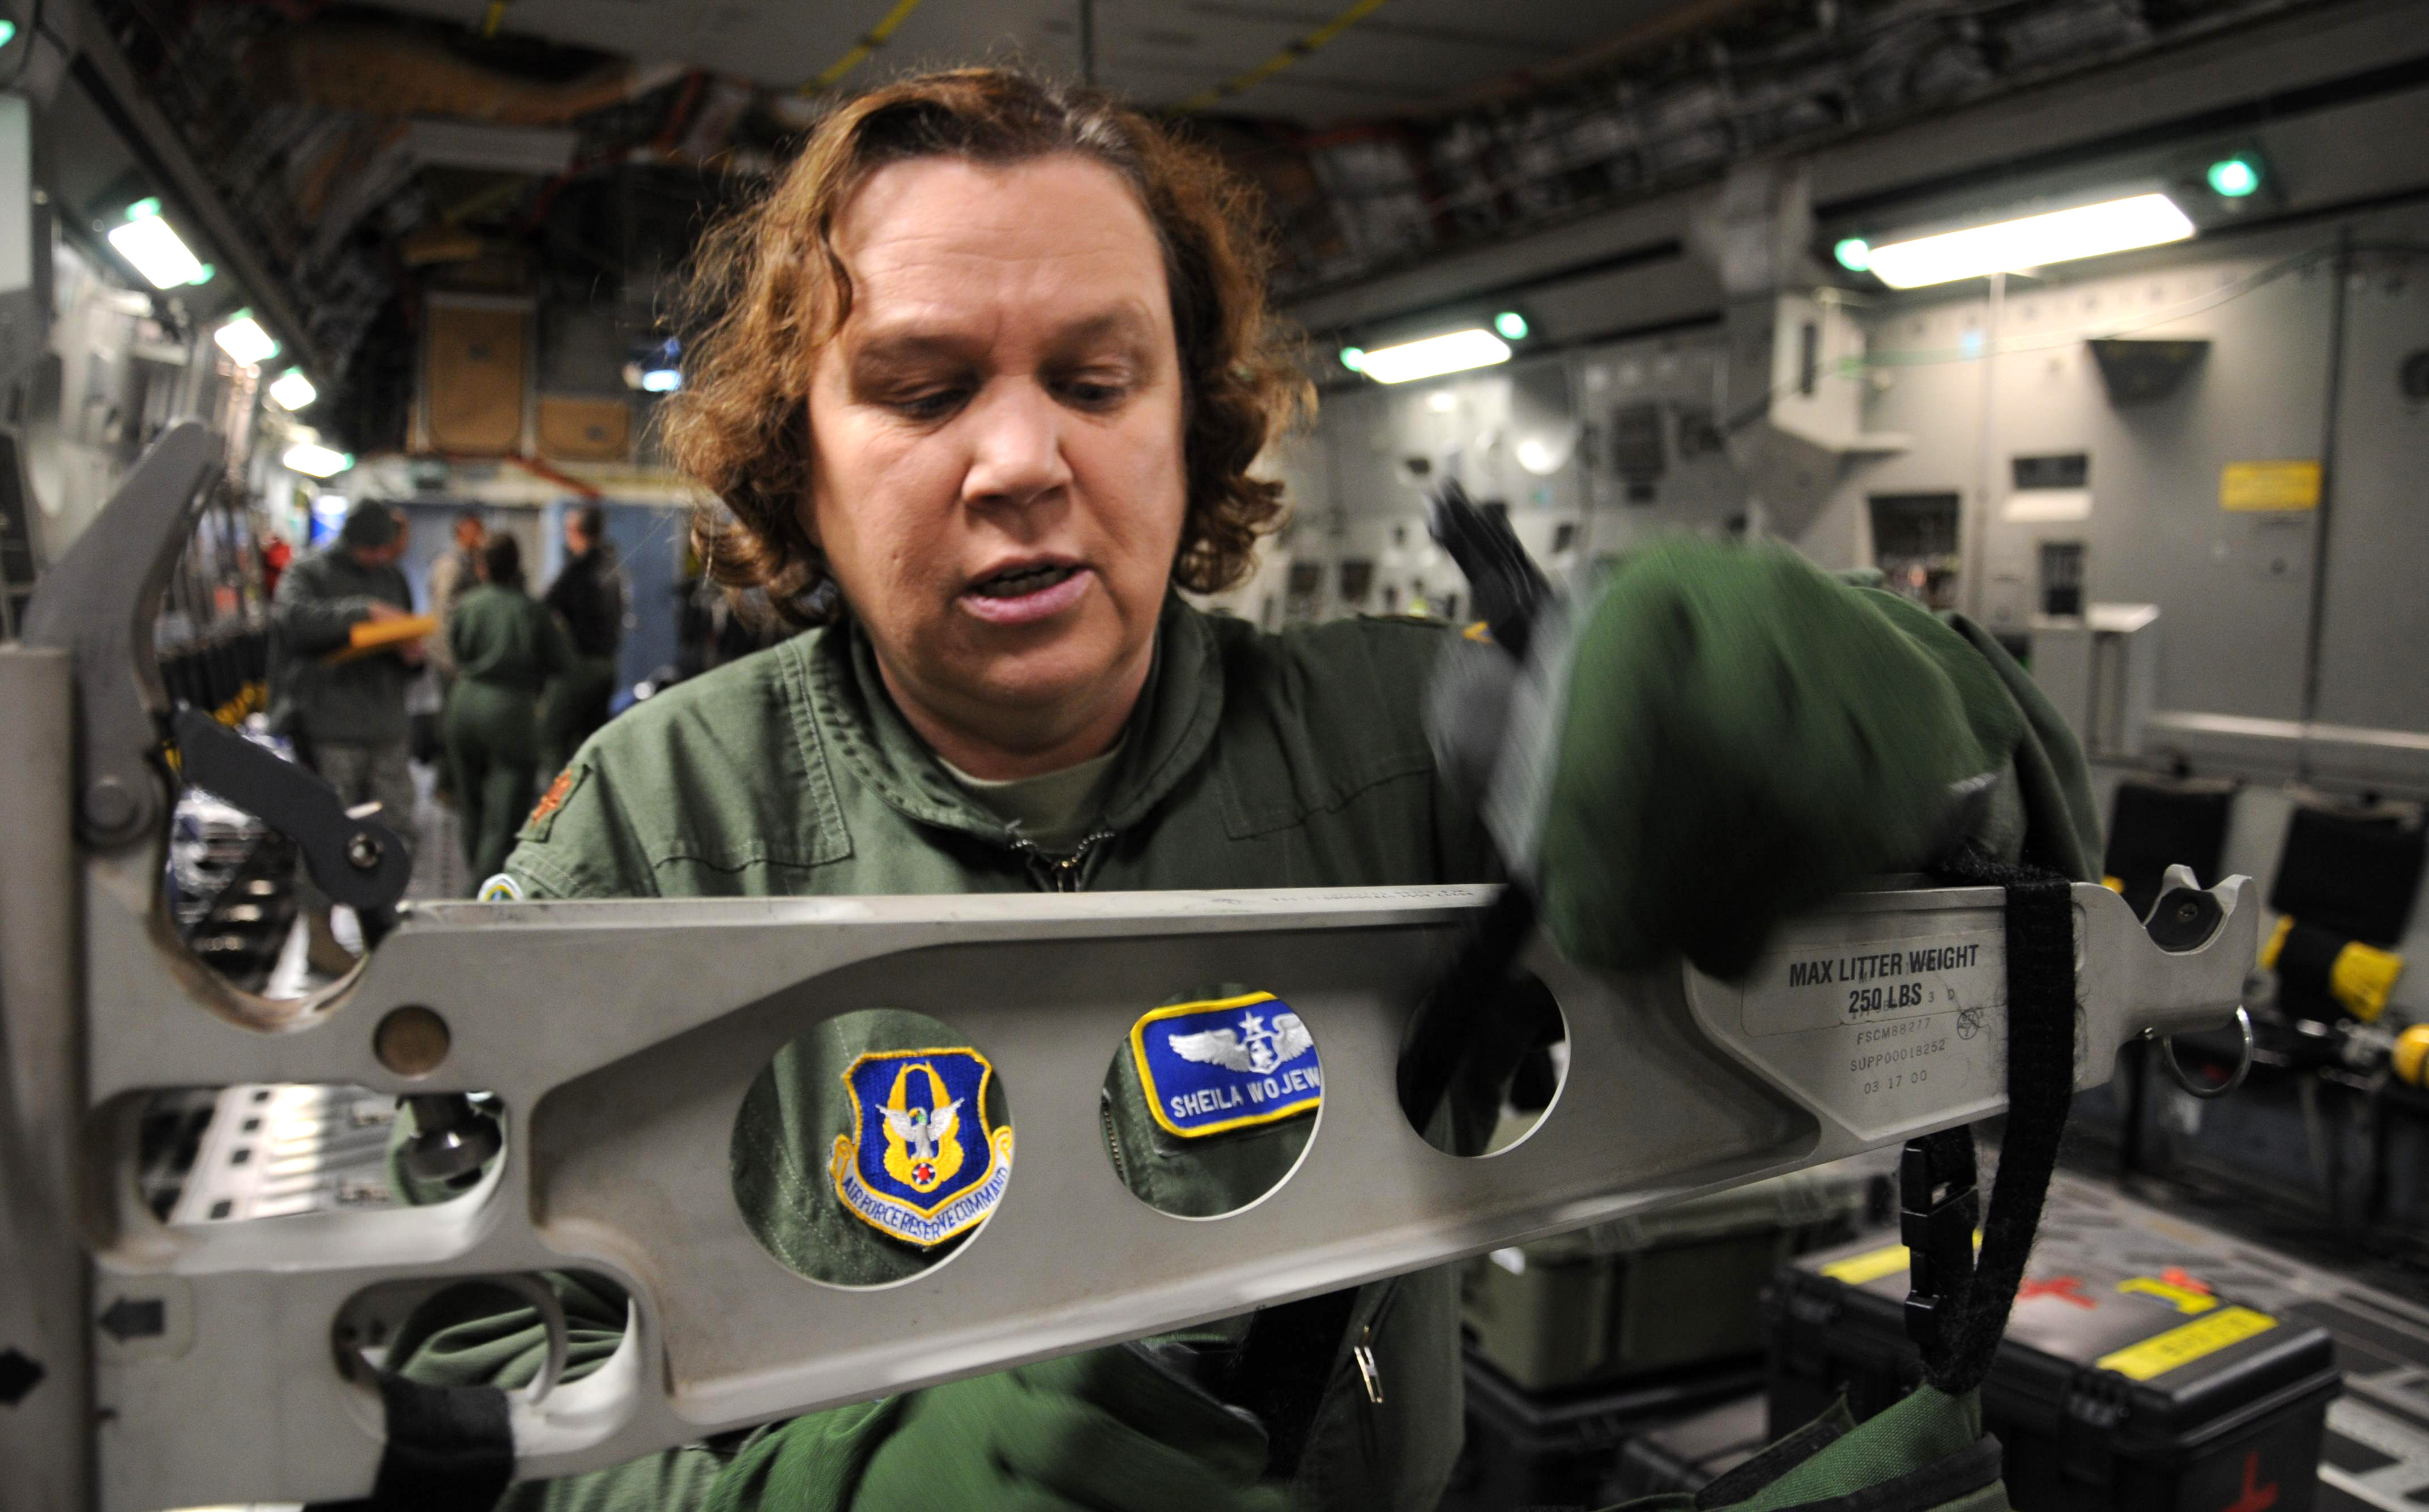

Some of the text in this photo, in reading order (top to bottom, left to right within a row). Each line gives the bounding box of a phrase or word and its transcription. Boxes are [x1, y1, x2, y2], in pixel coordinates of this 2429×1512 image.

[1789, 944, 1979, 987] MAX LITTER WEIGHT
[1848, 987, 1882, 1013] 250
[1888, 982, 1922, 1008] LBS
[1864, 1070, 1928, 1094] 03 17 00
[1170, 1084, 1245, 1118] SHEILA
[842, 1176, 864, 1204] AIR
[860, 1194, 902, 1226] FORCE
[900, 1208, 956, 1240] RESERVE
